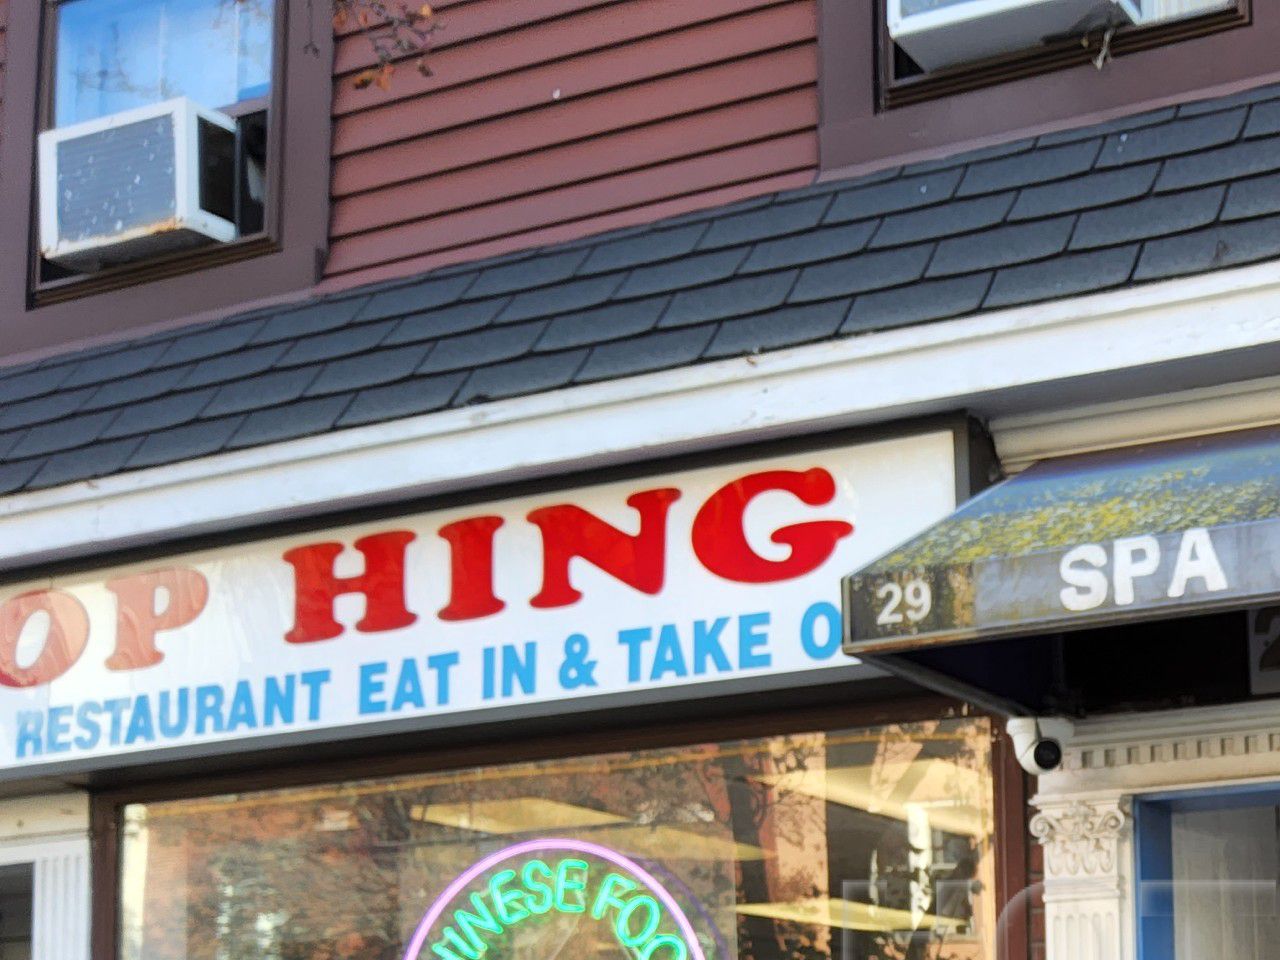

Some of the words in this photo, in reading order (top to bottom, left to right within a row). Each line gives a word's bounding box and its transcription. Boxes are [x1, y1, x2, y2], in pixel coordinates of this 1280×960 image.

[283, 466, 855, 645] HING
[876, 579, 932, 626] 29
[1059, 528, 1228, 612] SPA
[15, 668, 331, 760] RESTAURANT
[357, 651, 460, 716] EAT
[481, 640, 537, 700] IN
[560, 633, 599, 691] &
[618, 611, 772, 681] TAKE
